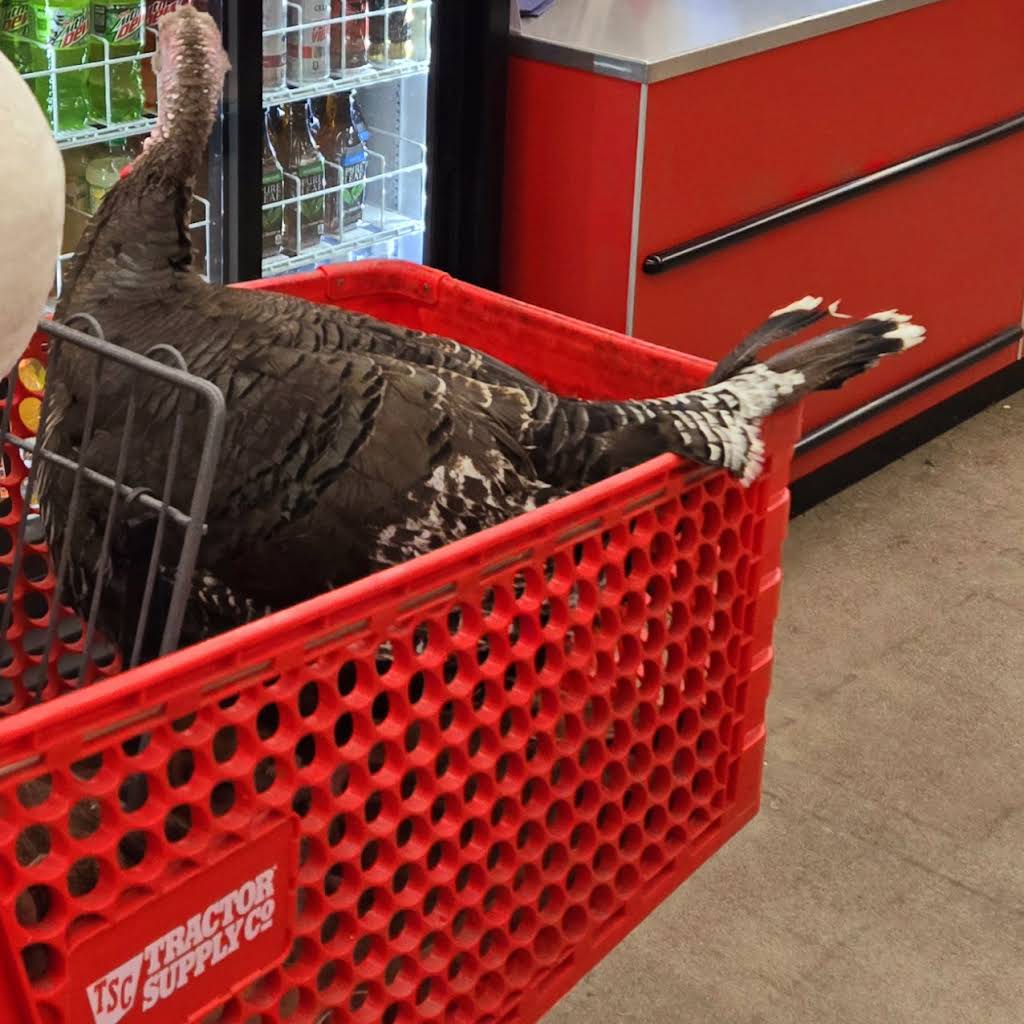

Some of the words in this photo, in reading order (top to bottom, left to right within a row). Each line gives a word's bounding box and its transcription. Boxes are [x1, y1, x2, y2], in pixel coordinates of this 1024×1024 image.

[143, 868, 275, 974] TRACTOR
[93, 972, 135, 1014] TSC
[142, 922, 244, 1013] SUPPLY
